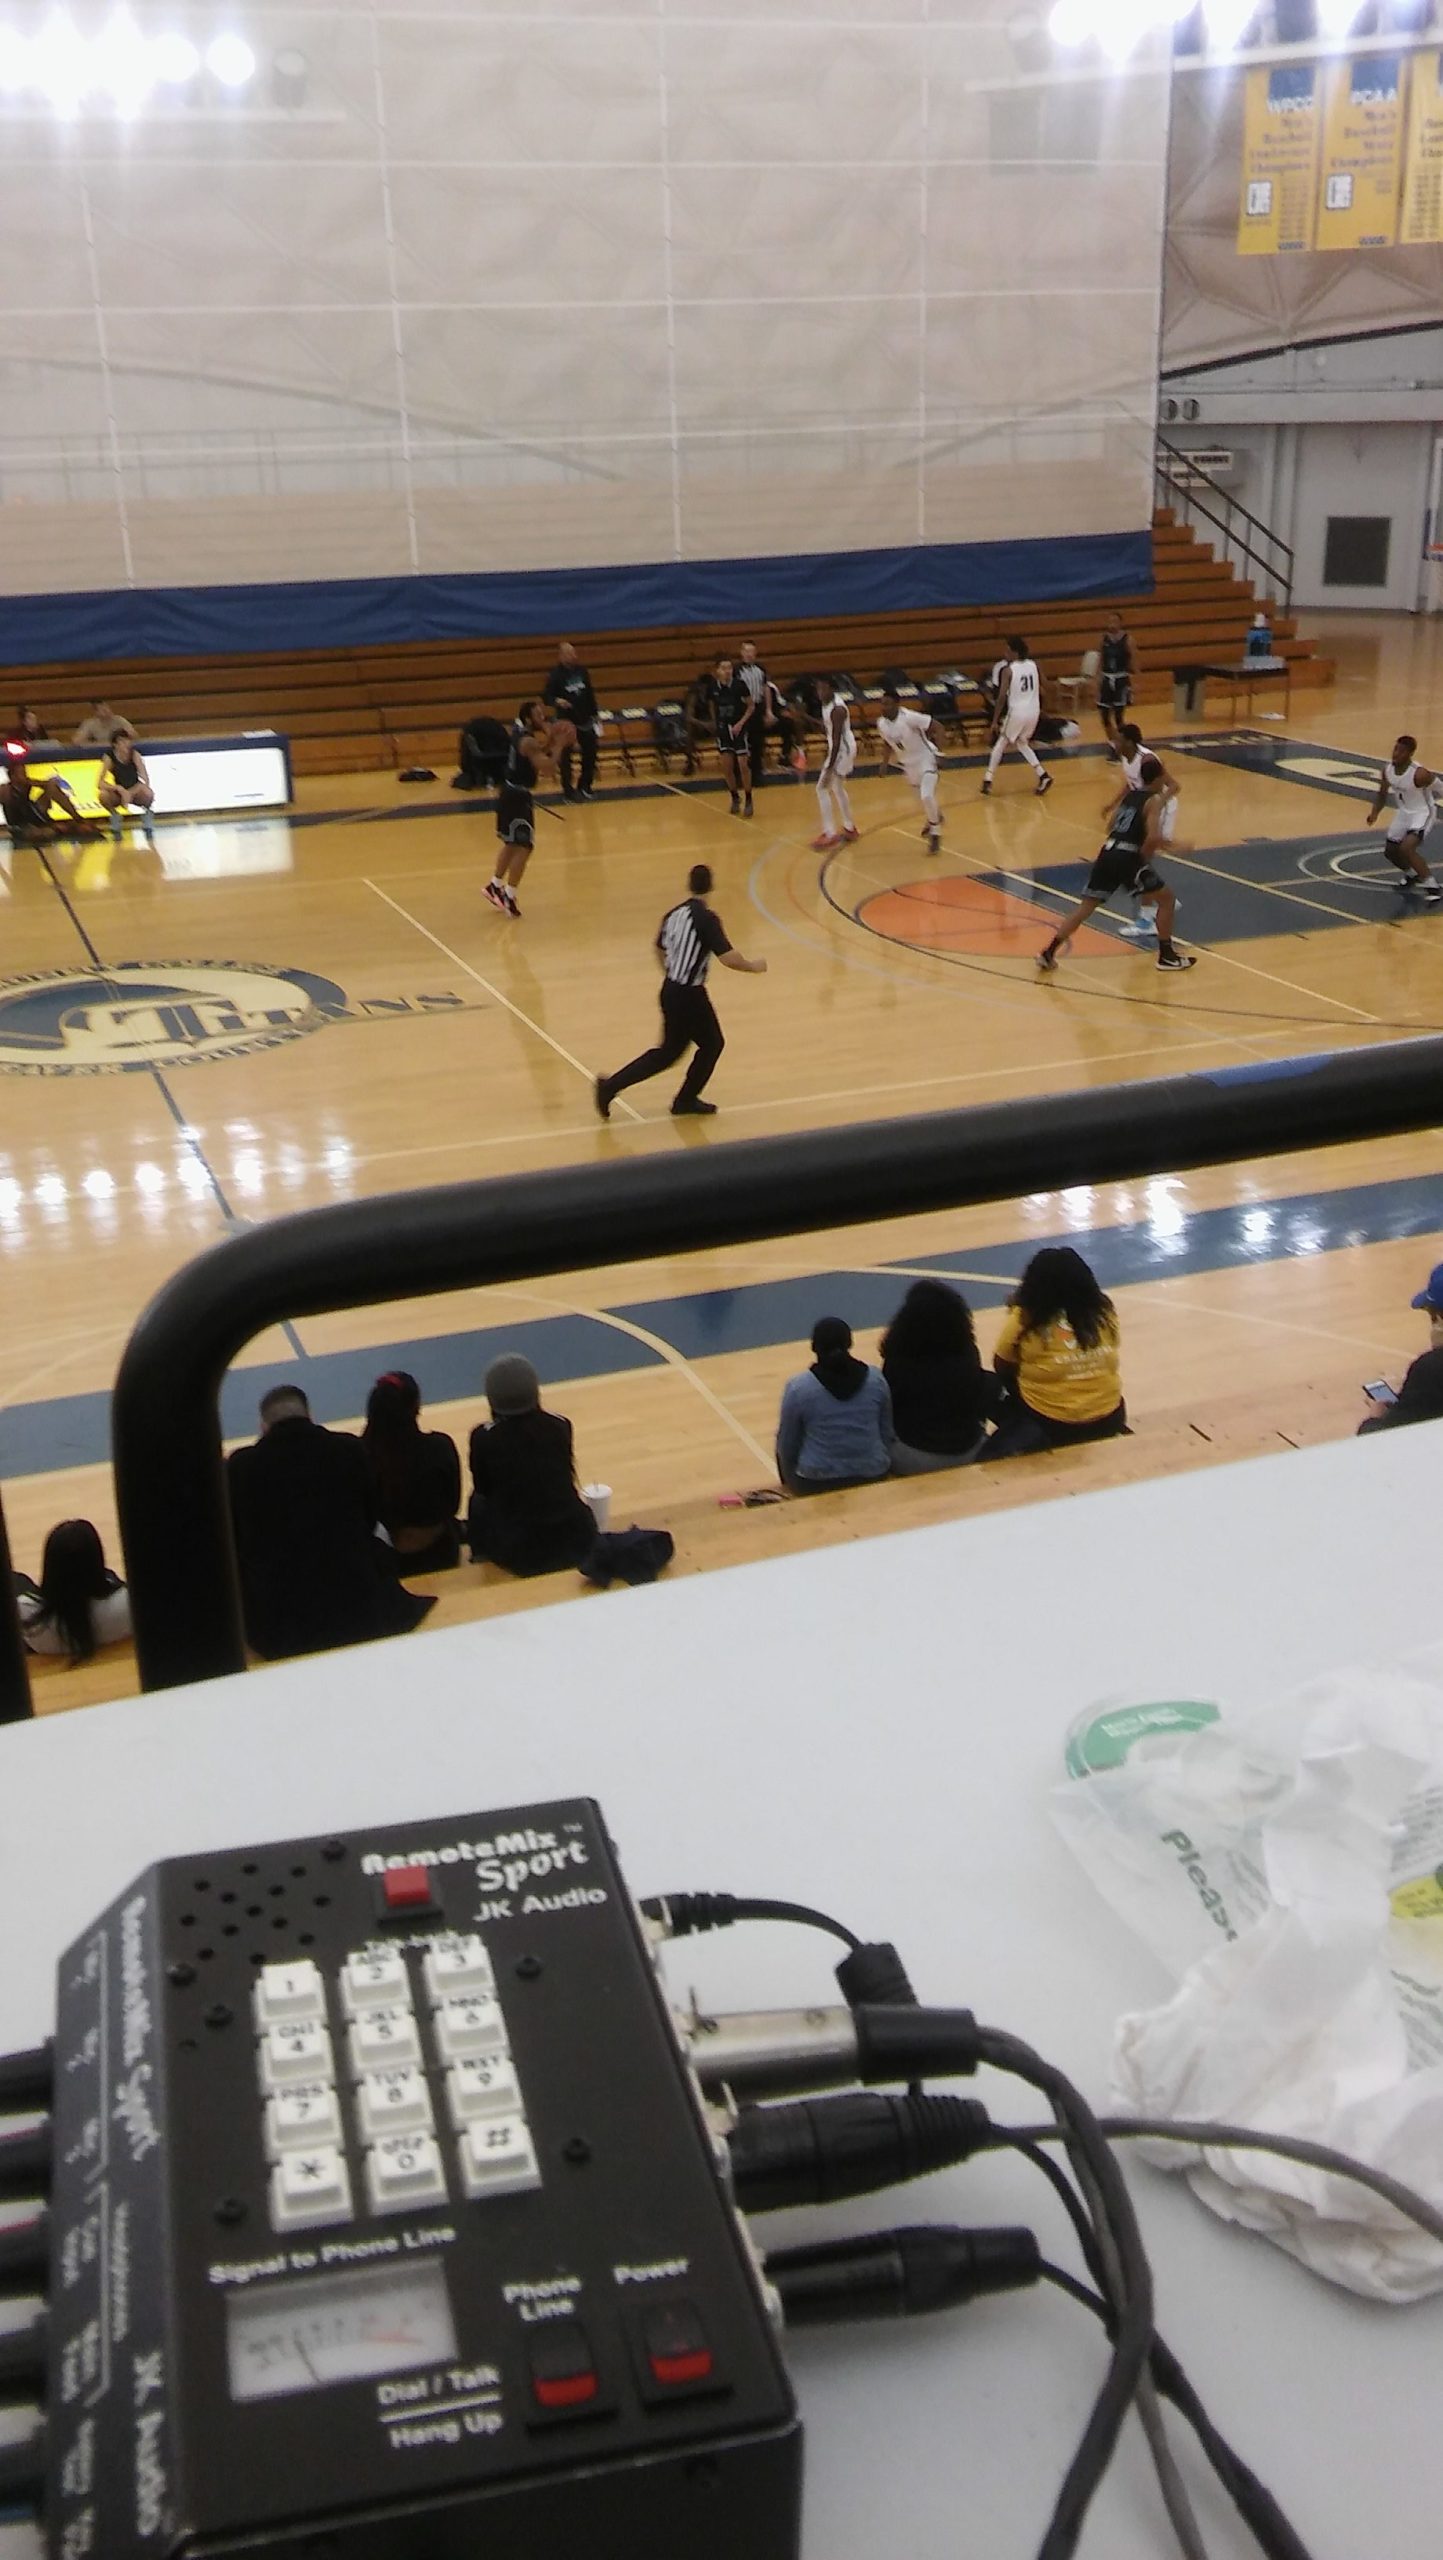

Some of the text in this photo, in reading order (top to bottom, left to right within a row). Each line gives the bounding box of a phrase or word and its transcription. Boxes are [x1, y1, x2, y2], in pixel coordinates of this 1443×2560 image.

[1020, 674, 1034, 692] 31
[361, 1828, 557, 1875] RemoteMix
[475, 1840, 589, 1891] Sport
[473, 1887, 607, 1922] JK Audio
[208, 2227, 456, 2284] Signal to Phone Line
[613, 2257, 690, 2285] Power
[503, 2275, 582, 2304] Phone
[519, 2300, 575, 2321] Line
[377, 2379, 429, 2405] Dial
[447, 2364, 500, 2392] Talk
[389, 2411, 504, 2449] Hang Up
